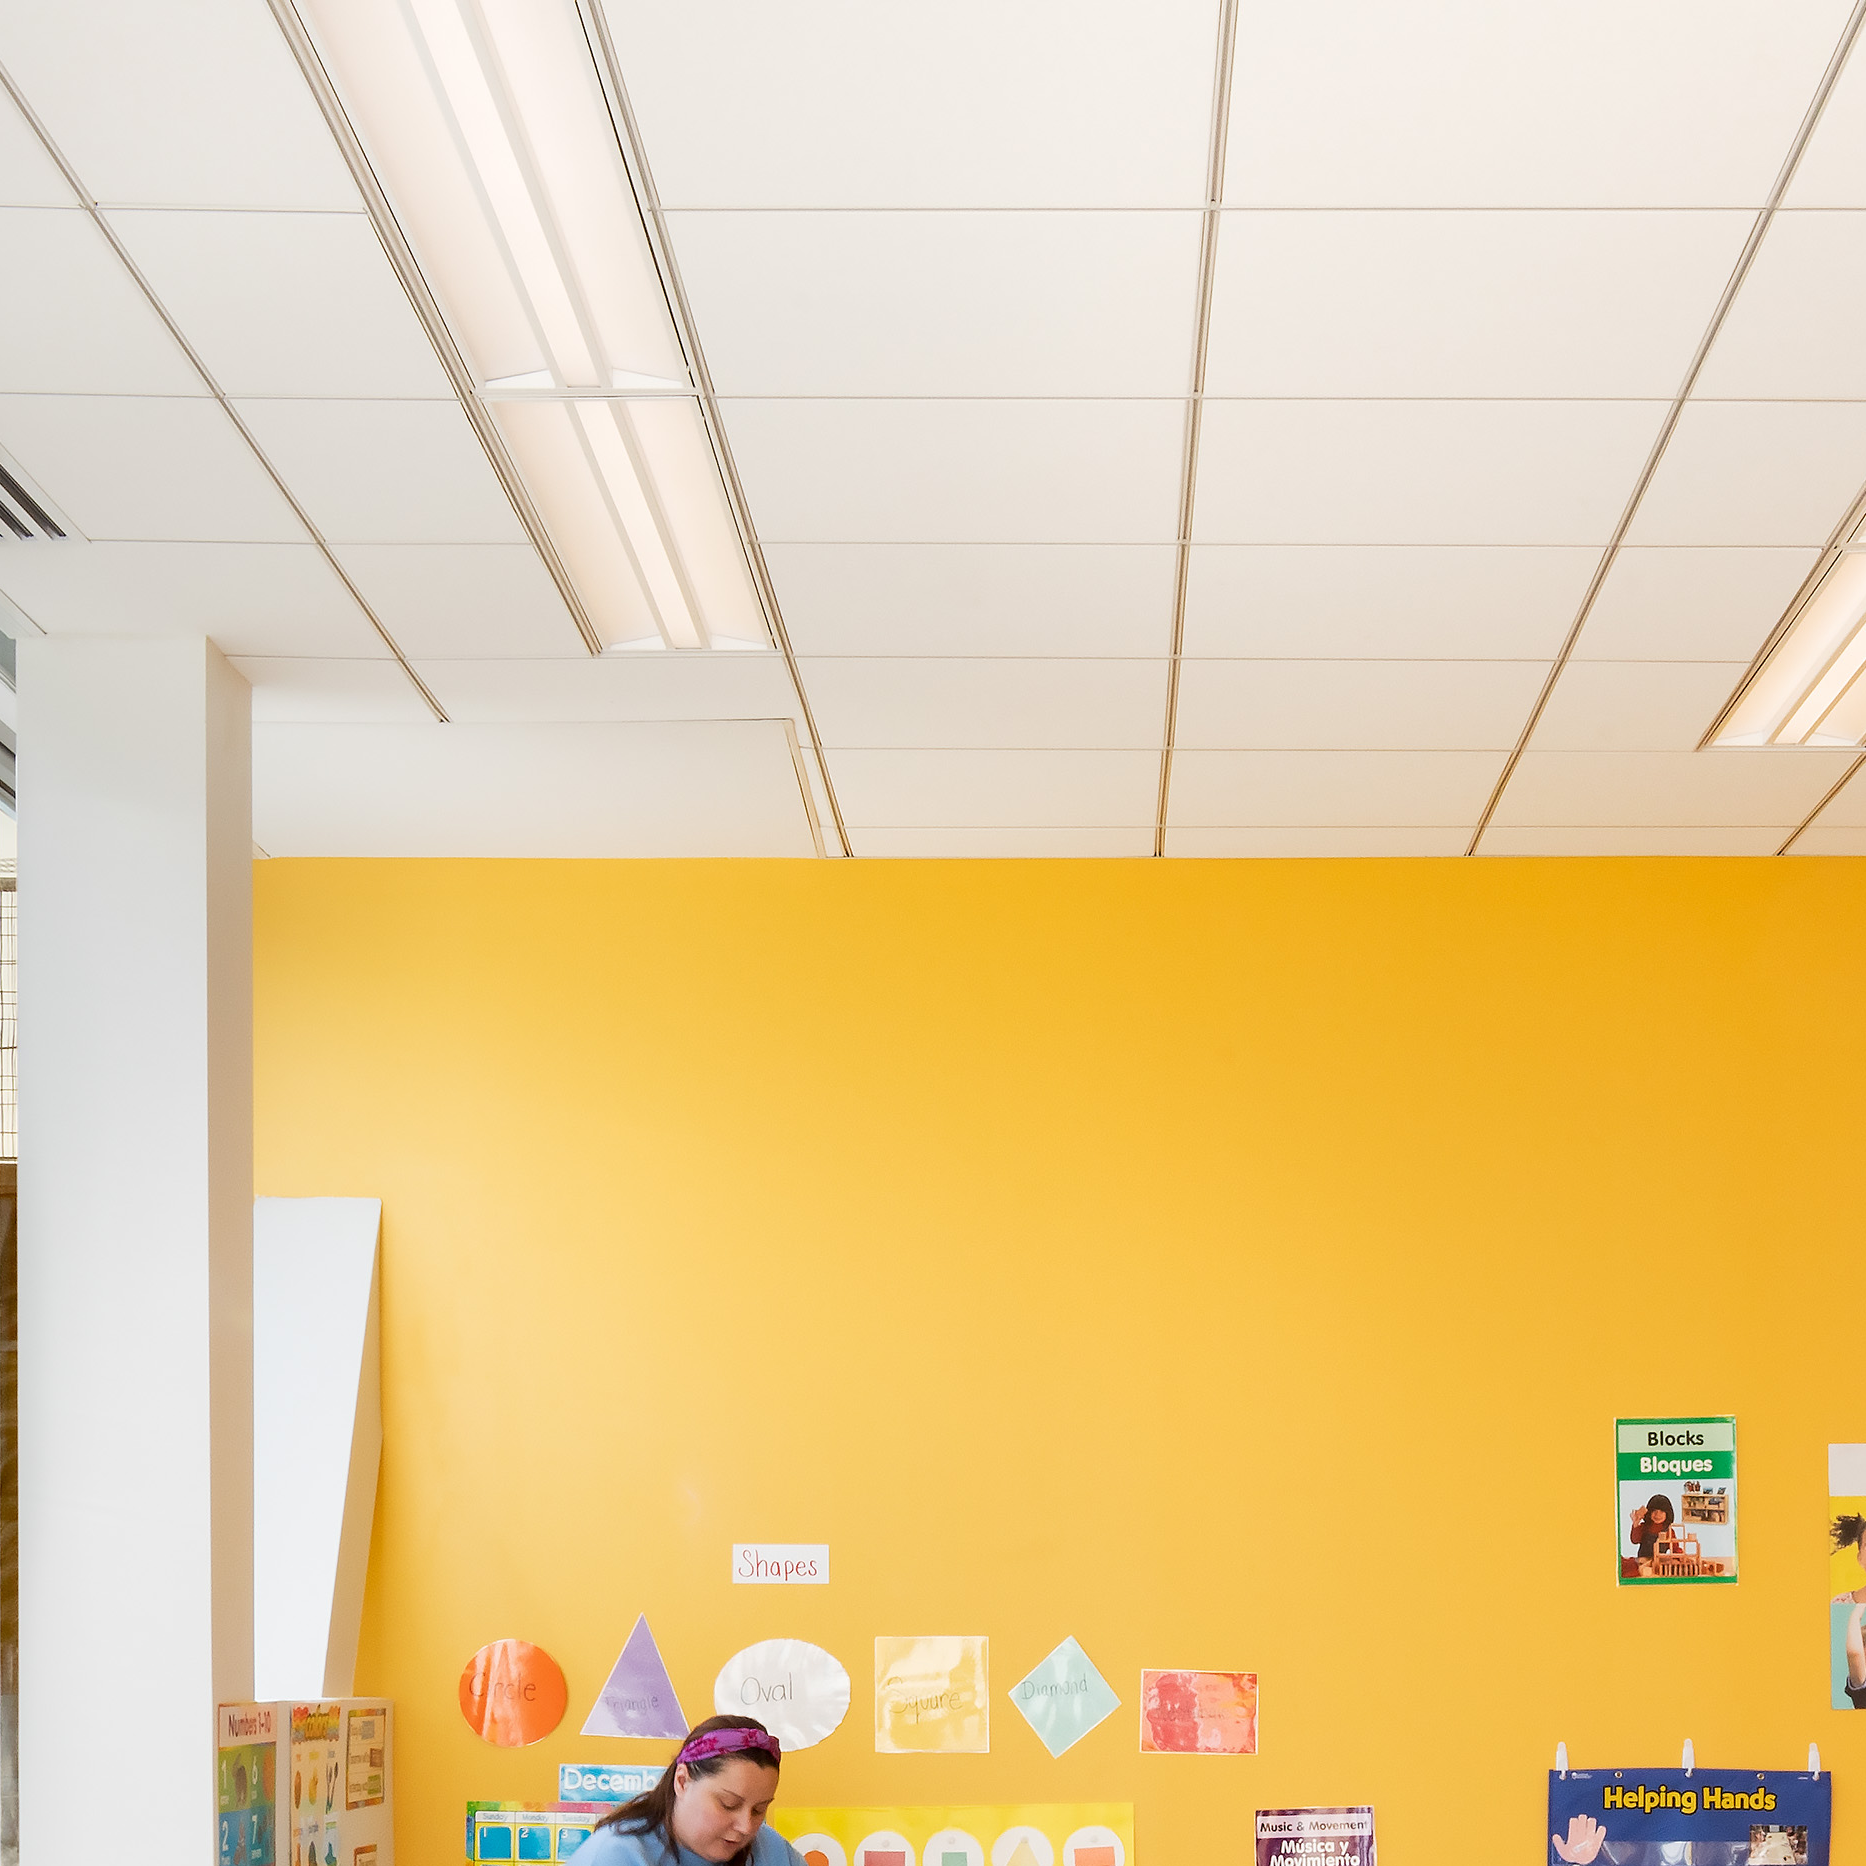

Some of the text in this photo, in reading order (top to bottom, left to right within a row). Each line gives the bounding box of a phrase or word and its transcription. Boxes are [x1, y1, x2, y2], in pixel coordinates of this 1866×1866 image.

[1647, 1430, 1705, 1447] Blocks
[1640, 1456, 1713, 1477] Bloques
[738, 1549, 818, 1581] Shapes
[469, 1671, 537, 1702] Crcle
[740, 1672, 794, 1706] Oval
[1021, 1673, 1088, 1700] Diamond
[221, 1759, 227, 1789] 1
[251, 1755, 258, 1785] 6
[564, 1767, 657, 1792] Decemb
[1602, 1784, 1777, 1815] Helping Hands
[251, 1814, 258, 1845] 7
[482, 1812, 591, 1823] Sunday Monday Tuesday
[1260, 1820, 1368, 1833] Music & Movement
[222, 1820, 229, 1851] 2
[483, 1827, 568, 1839] 1 2 3
[1280, 1838, 1350, 1855] Música y
